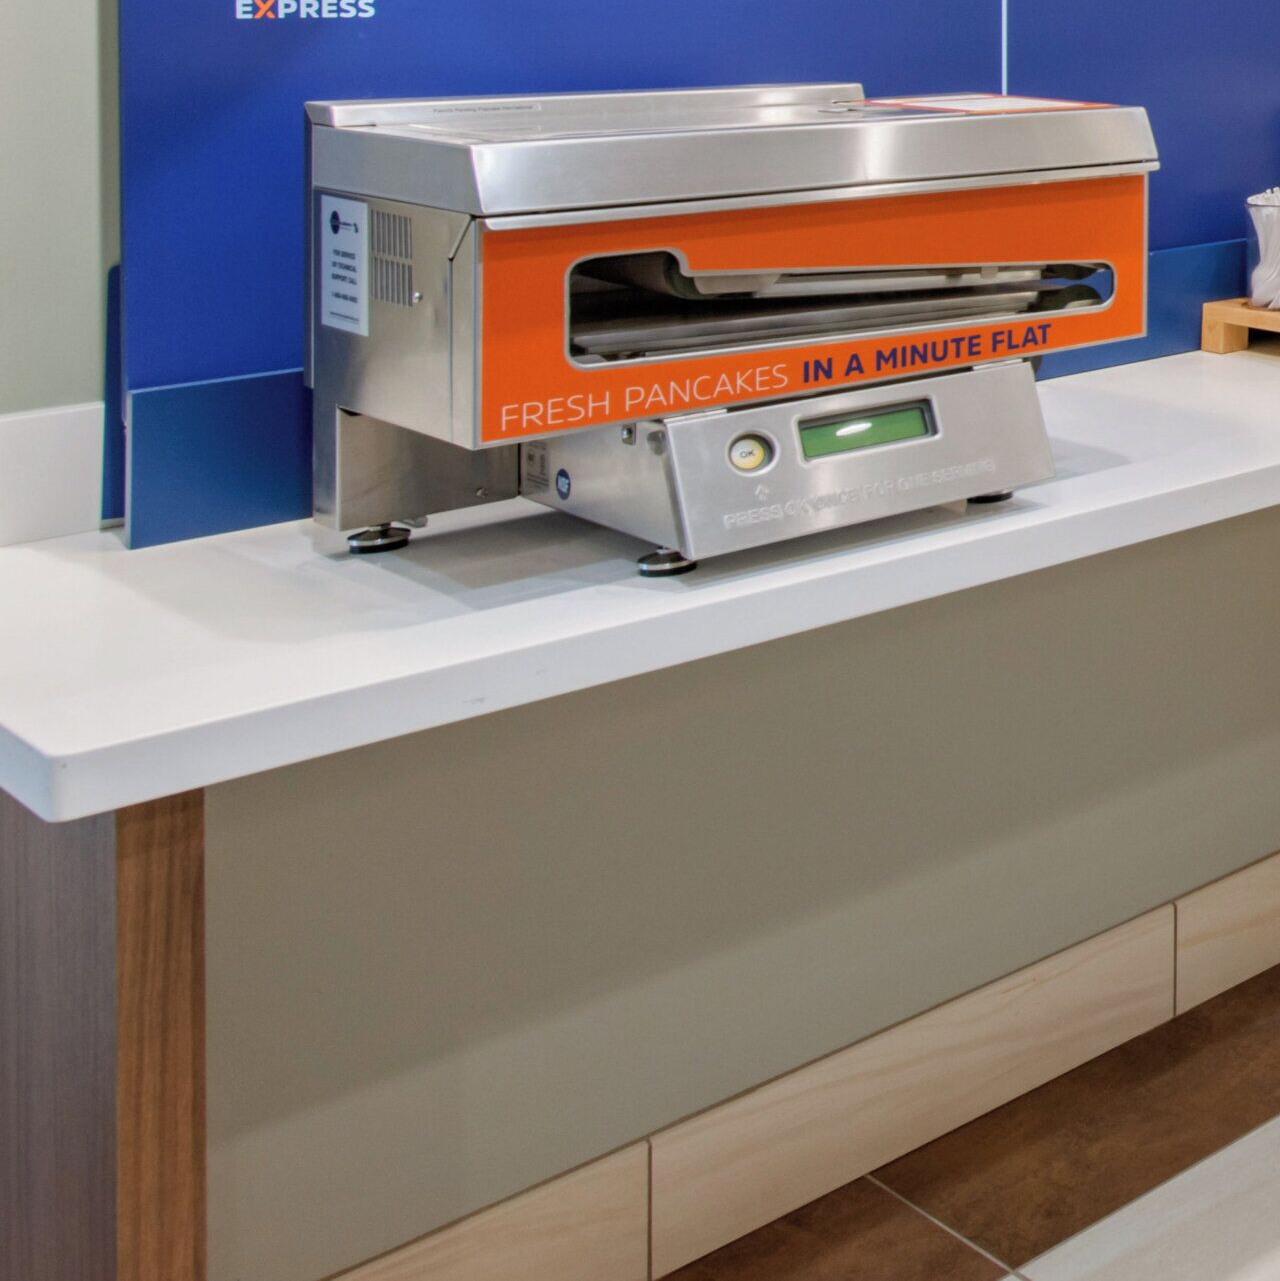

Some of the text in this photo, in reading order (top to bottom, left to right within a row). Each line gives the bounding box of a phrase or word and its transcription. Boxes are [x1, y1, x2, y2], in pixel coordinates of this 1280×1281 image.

[501, 323, 1052, 432] FRESH PANCAKES IN A MINUTE FLAT
[740, 449, 755, 459] OK
